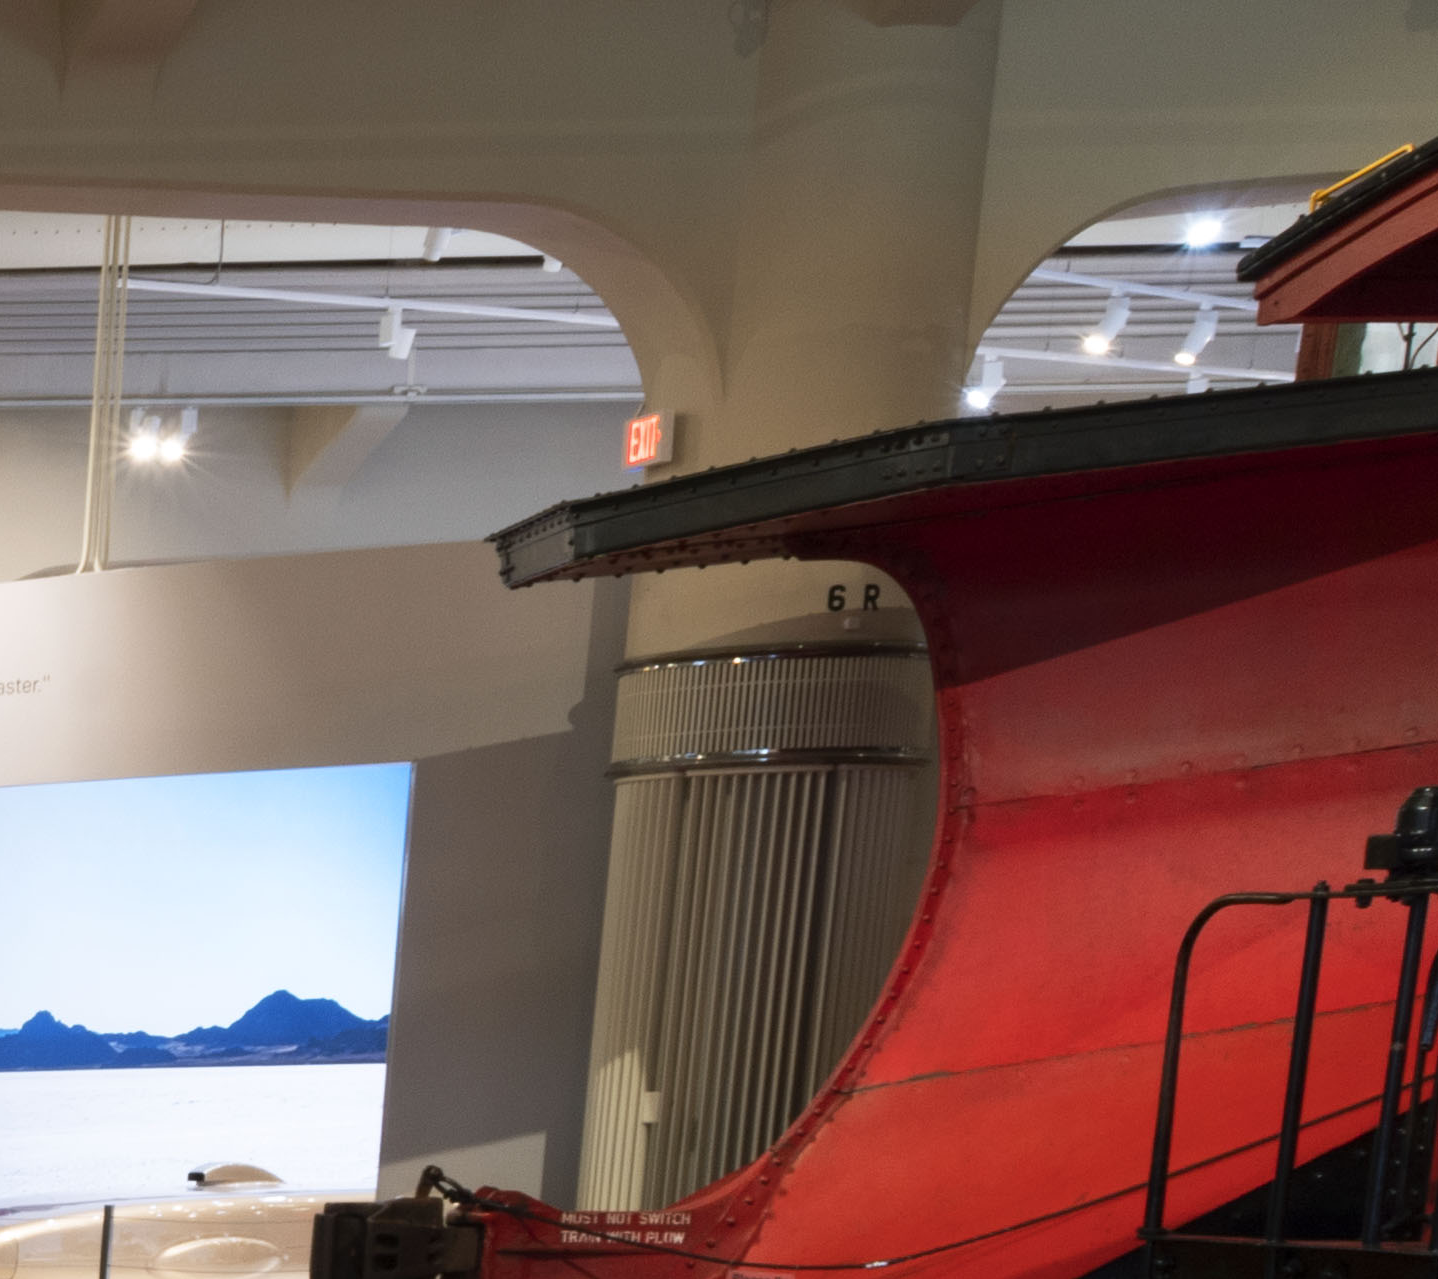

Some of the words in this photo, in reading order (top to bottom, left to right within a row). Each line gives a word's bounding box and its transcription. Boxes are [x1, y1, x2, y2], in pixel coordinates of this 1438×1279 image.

[628, 416, 659, 464] EXIT
[828, 585, 846, 612] 6
[864, 584, 880, 611] R
[561, 1213, 599, 1225] MUST
[606, 1213, 633, 1225] NOT
[639, 1212, 691, 1225] SWITCH
[645, 1231, 686, 1245] PLOW
